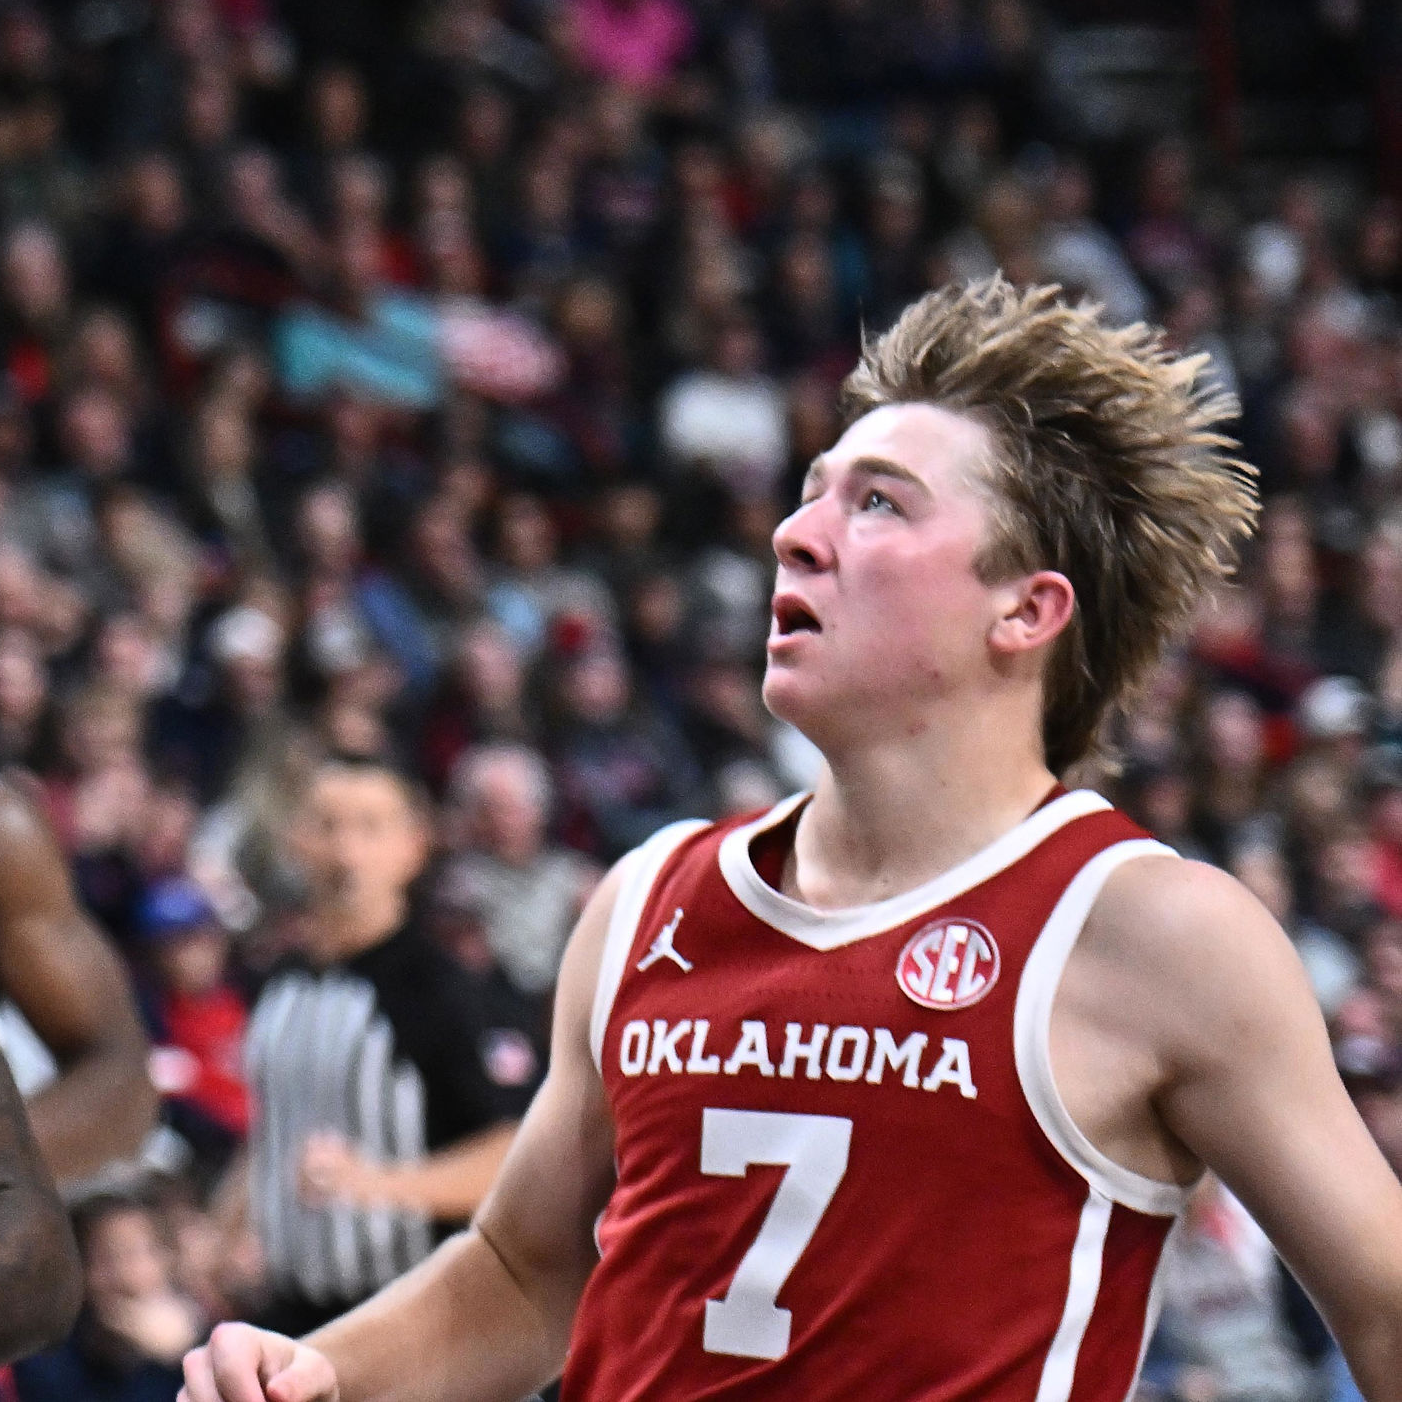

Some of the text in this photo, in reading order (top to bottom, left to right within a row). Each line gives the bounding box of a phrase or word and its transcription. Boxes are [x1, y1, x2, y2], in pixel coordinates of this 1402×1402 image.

[904, 925, 992, 1003] SEC
[620, 1019, 977, 1099] OKLAHOMA
[700, 1108, 853, 1361] 7
